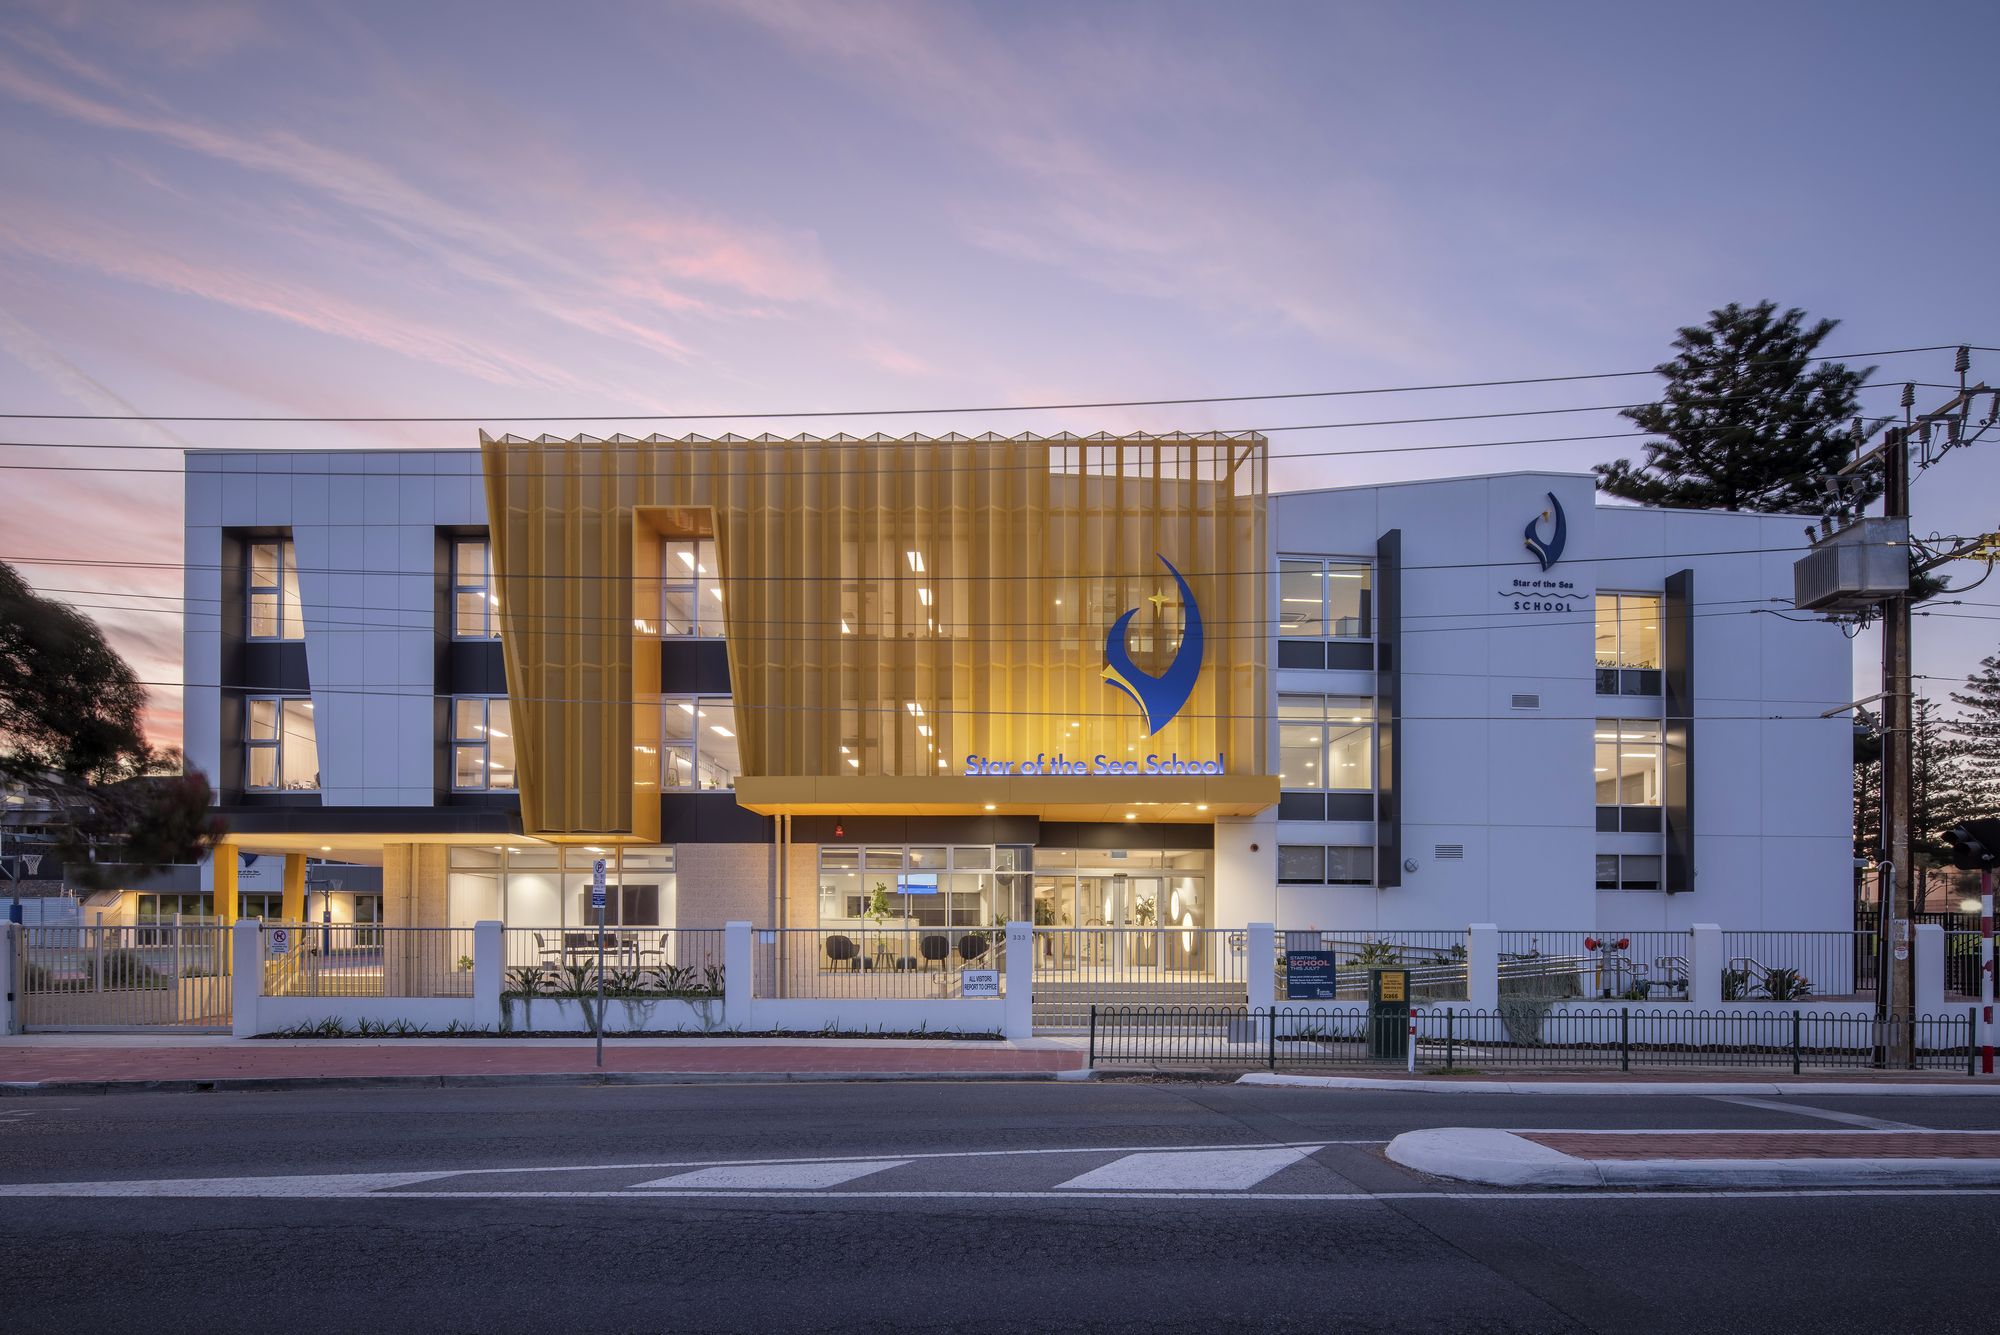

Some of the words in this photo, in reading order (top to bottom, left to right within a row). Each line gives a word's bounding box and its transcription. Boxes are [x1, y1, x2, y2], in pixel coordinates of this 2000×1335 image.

[1513, 579, 1530, 587] Star
[1532, 580, 1541, 588] of
[1543, 580, 1556, 588] the
[1559, 581, 1573, 589] Sea
[1514, 601, 1572, 612] SCHOOL
[965, 754, 1014, 775] Star
[1020, 753, 1045, 775] of
[1050, 753, 1087, 775] the
[1093, 754, 1138, 775] Sea
[1145, 753, 1224, 775] School
